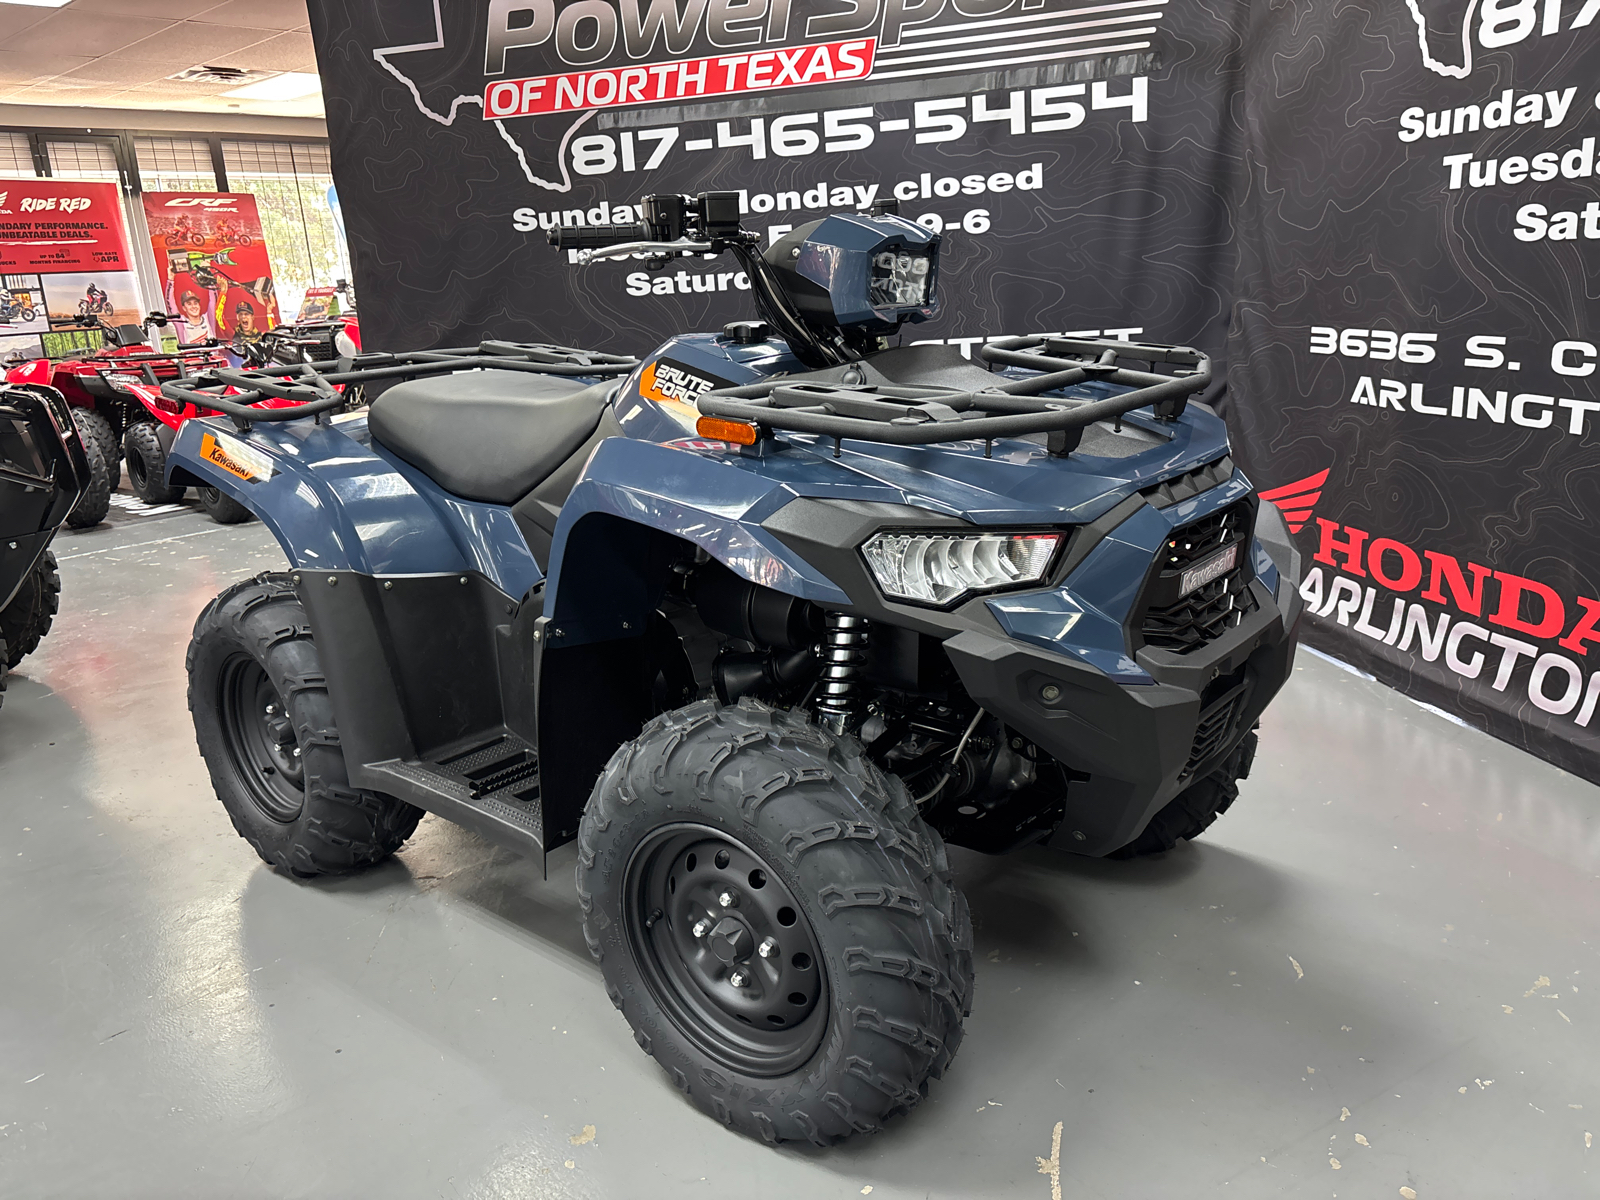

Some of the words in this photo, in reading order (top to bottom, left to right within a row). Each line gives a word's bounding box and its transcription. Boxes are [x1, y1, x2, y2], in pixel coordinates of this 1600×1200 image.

[490, 80, 547, 115] OF
[555, 61, 707, 109] NORTH
[717, 42, 867, 90] TEXAS
[571, 76, 1149, 176] 817-465-5454
[1398, 86, 1578, 143] Sunday
[1443, 137, 1600, 190] Tuesd
[894, 163, 1043, 201] closed
[20, 197, 57, 213] RIDE
[59, 197, 92, 214] RED
[164, 198, 238, 207] CRF
[35, 222, 109, 230] PERFORMANCE.
[60, 231, 93, 239] DEALS.
[1309, 326, 1439, 365] 3636
[1464, 335, 1521, 371] S.
[650, 377, 701, 407] FORC
[655, 364, 715, 395] BRUTE
[208, 447, 251, 478] Kawasaki
[1181, 546, 1238, 595] Kawasaki
